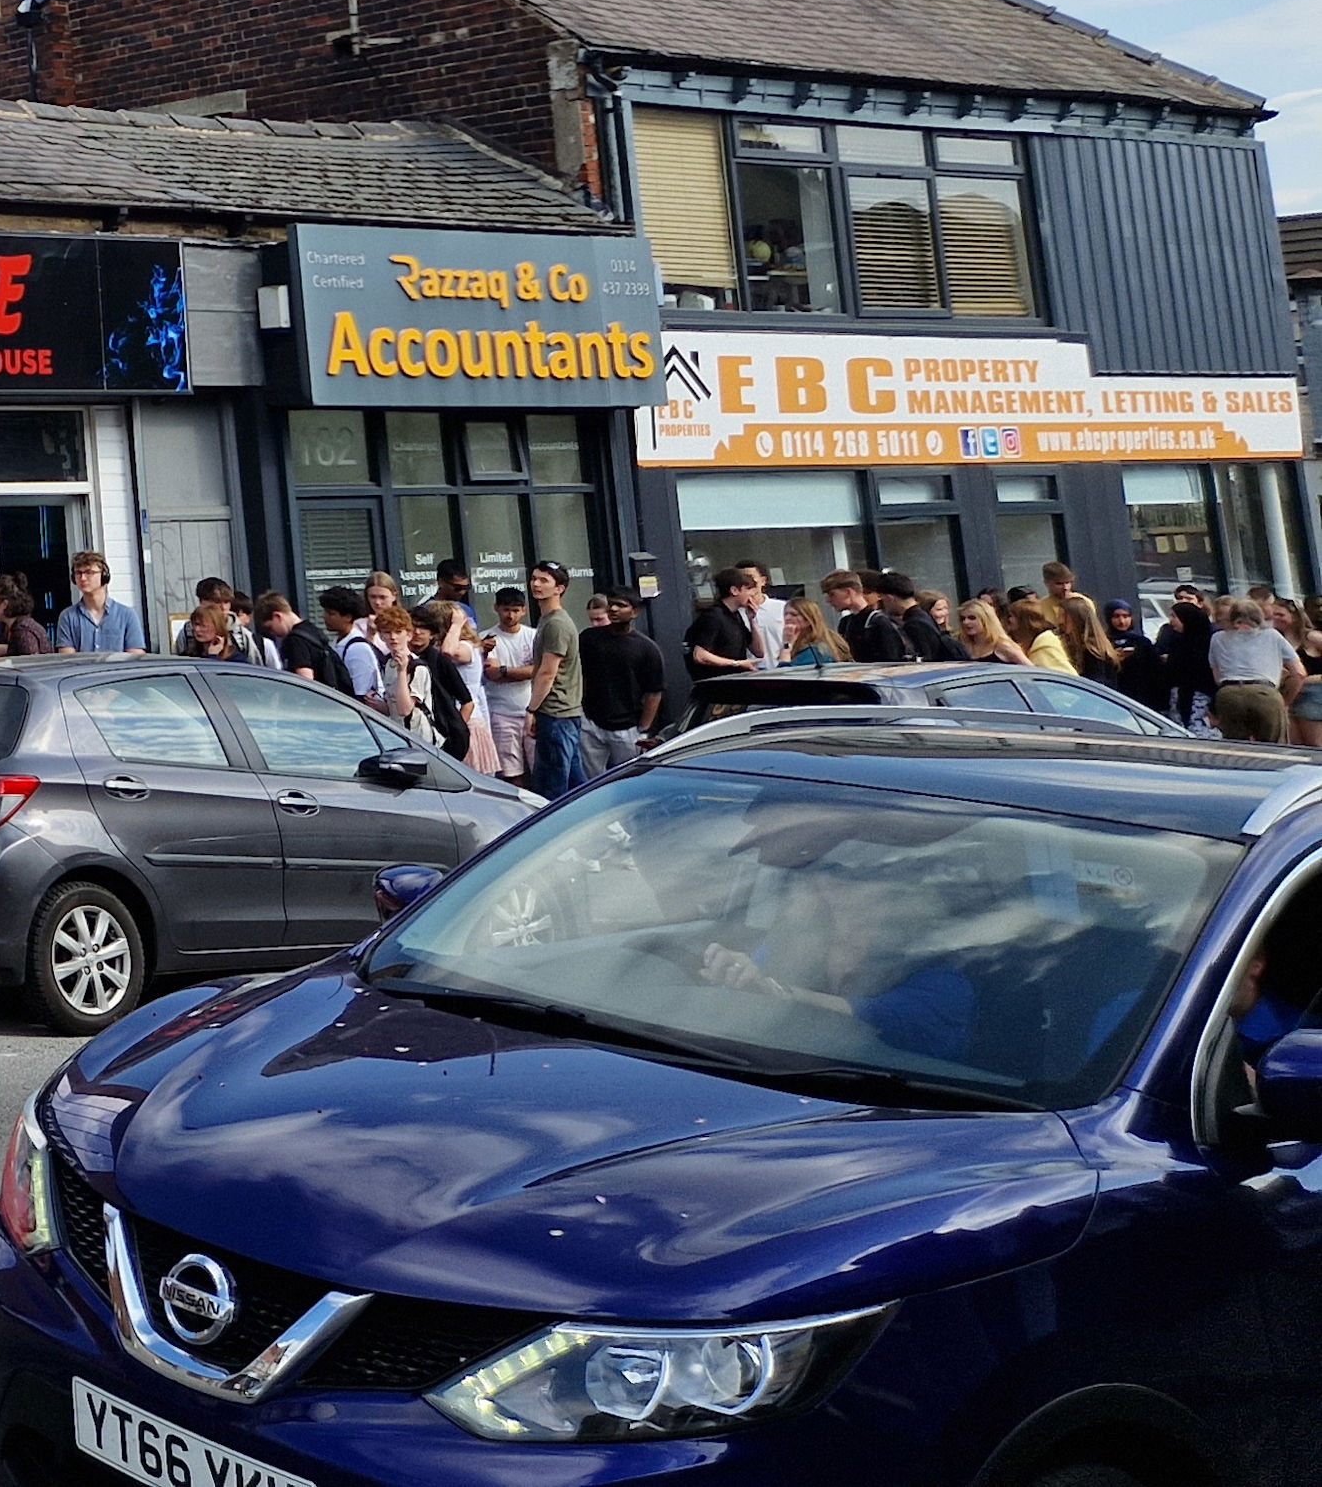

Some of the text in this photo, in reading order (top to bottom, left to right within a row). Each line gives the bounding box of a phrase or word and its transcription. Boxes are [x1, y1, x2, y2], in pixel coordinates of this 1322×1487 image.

[306, 251, 366, 266] Chartered
[610, 259, 637, 273] 0114
[312, 274, 365, 289] Certified
[389, 254, 590, 309] Razzaq & Co
[602, 281, 650, 296] 437 2399
[326, 311, 655, 380] Accountants
[903, 358, 1039, 383] PROPERTY
[906, 389, 1294, 418] MANAGEMENT, LETTING & SALES
[659, 423, 711, 438] PROPERTIES
[781, 429, 920, 458] 0114 268 5011
[1036, 427, 1217, 455] www.ebcproperties.co.uk
[414, 552, 435, 566] Self
[479, 551, 514, 563] Limited
[476, 567, 519, 580] Company
[473, 582, 489, 594] Tax
[162, 1282, 221, 1315] NISSAN
[86, 1391, 192, 1487] YT66
